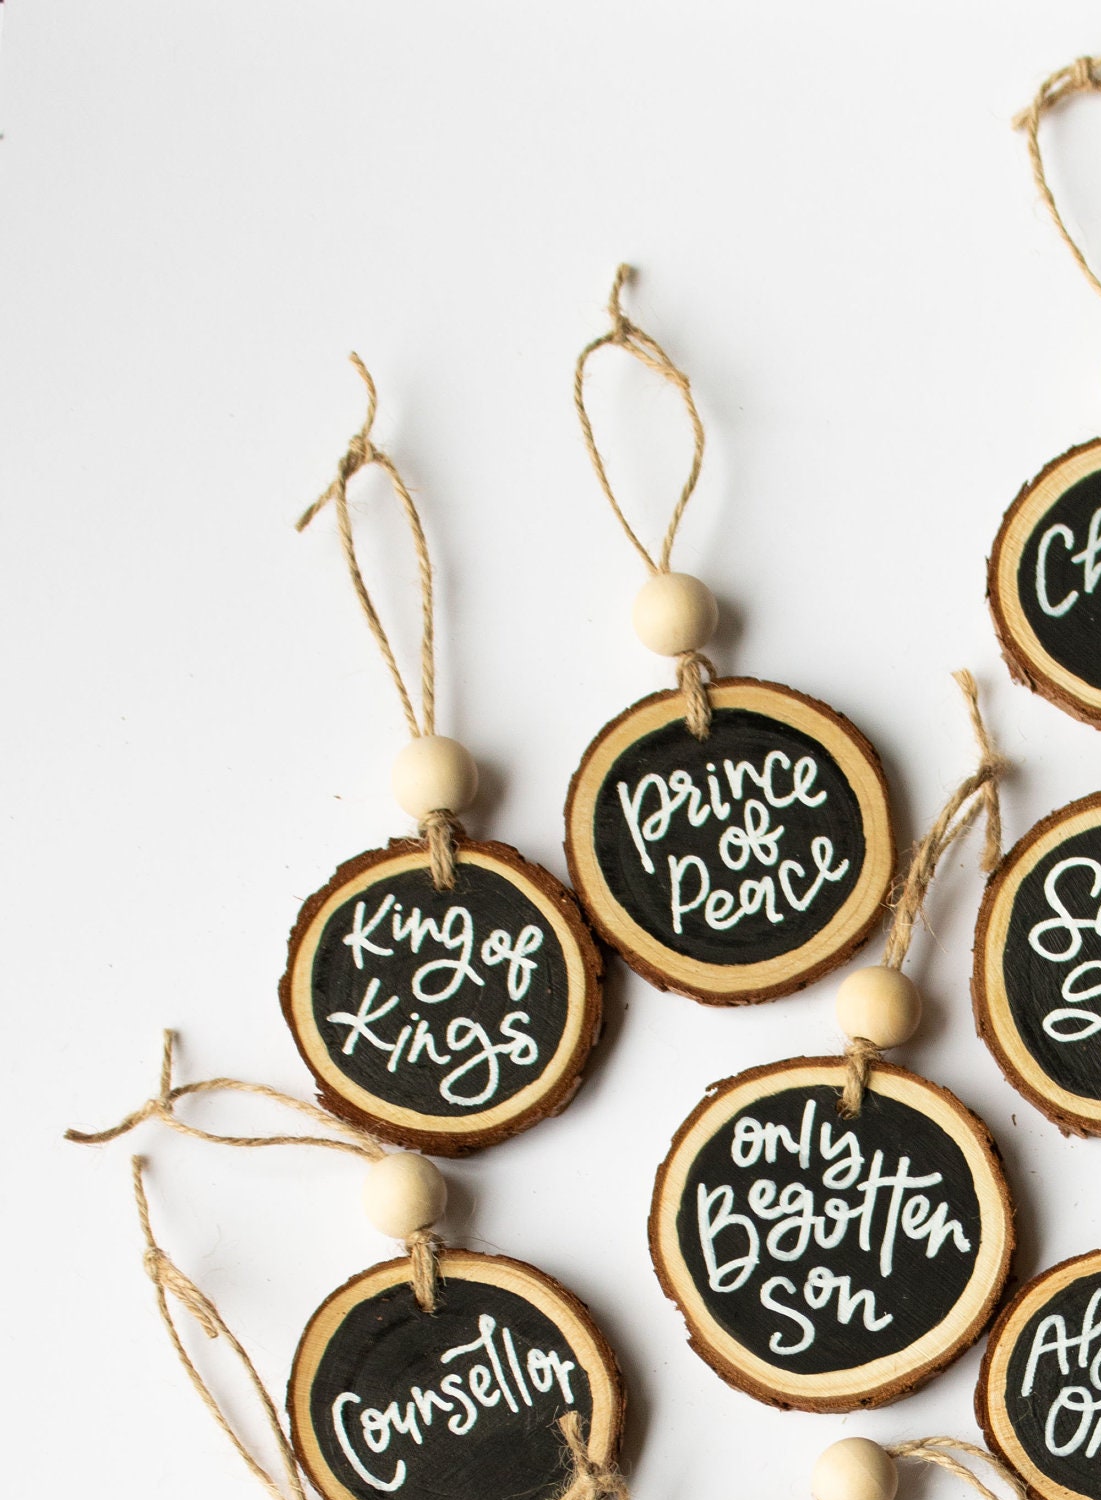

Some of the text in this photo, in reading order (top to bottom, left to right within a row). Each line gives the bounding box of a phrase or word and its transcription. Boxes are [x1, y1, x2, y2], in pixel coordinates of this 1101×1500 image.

[667, 835, 850, 935] Peace
[718, 798, 785, 871] of
[342, 893, 544, 1004] King of
[326, 977, 539, 1107] Kings
[696, 1149, 972, 1293] Begotten
[759, 1266, 894, 1356] Son
[331, 1313, 576, 1492] Counsellor
